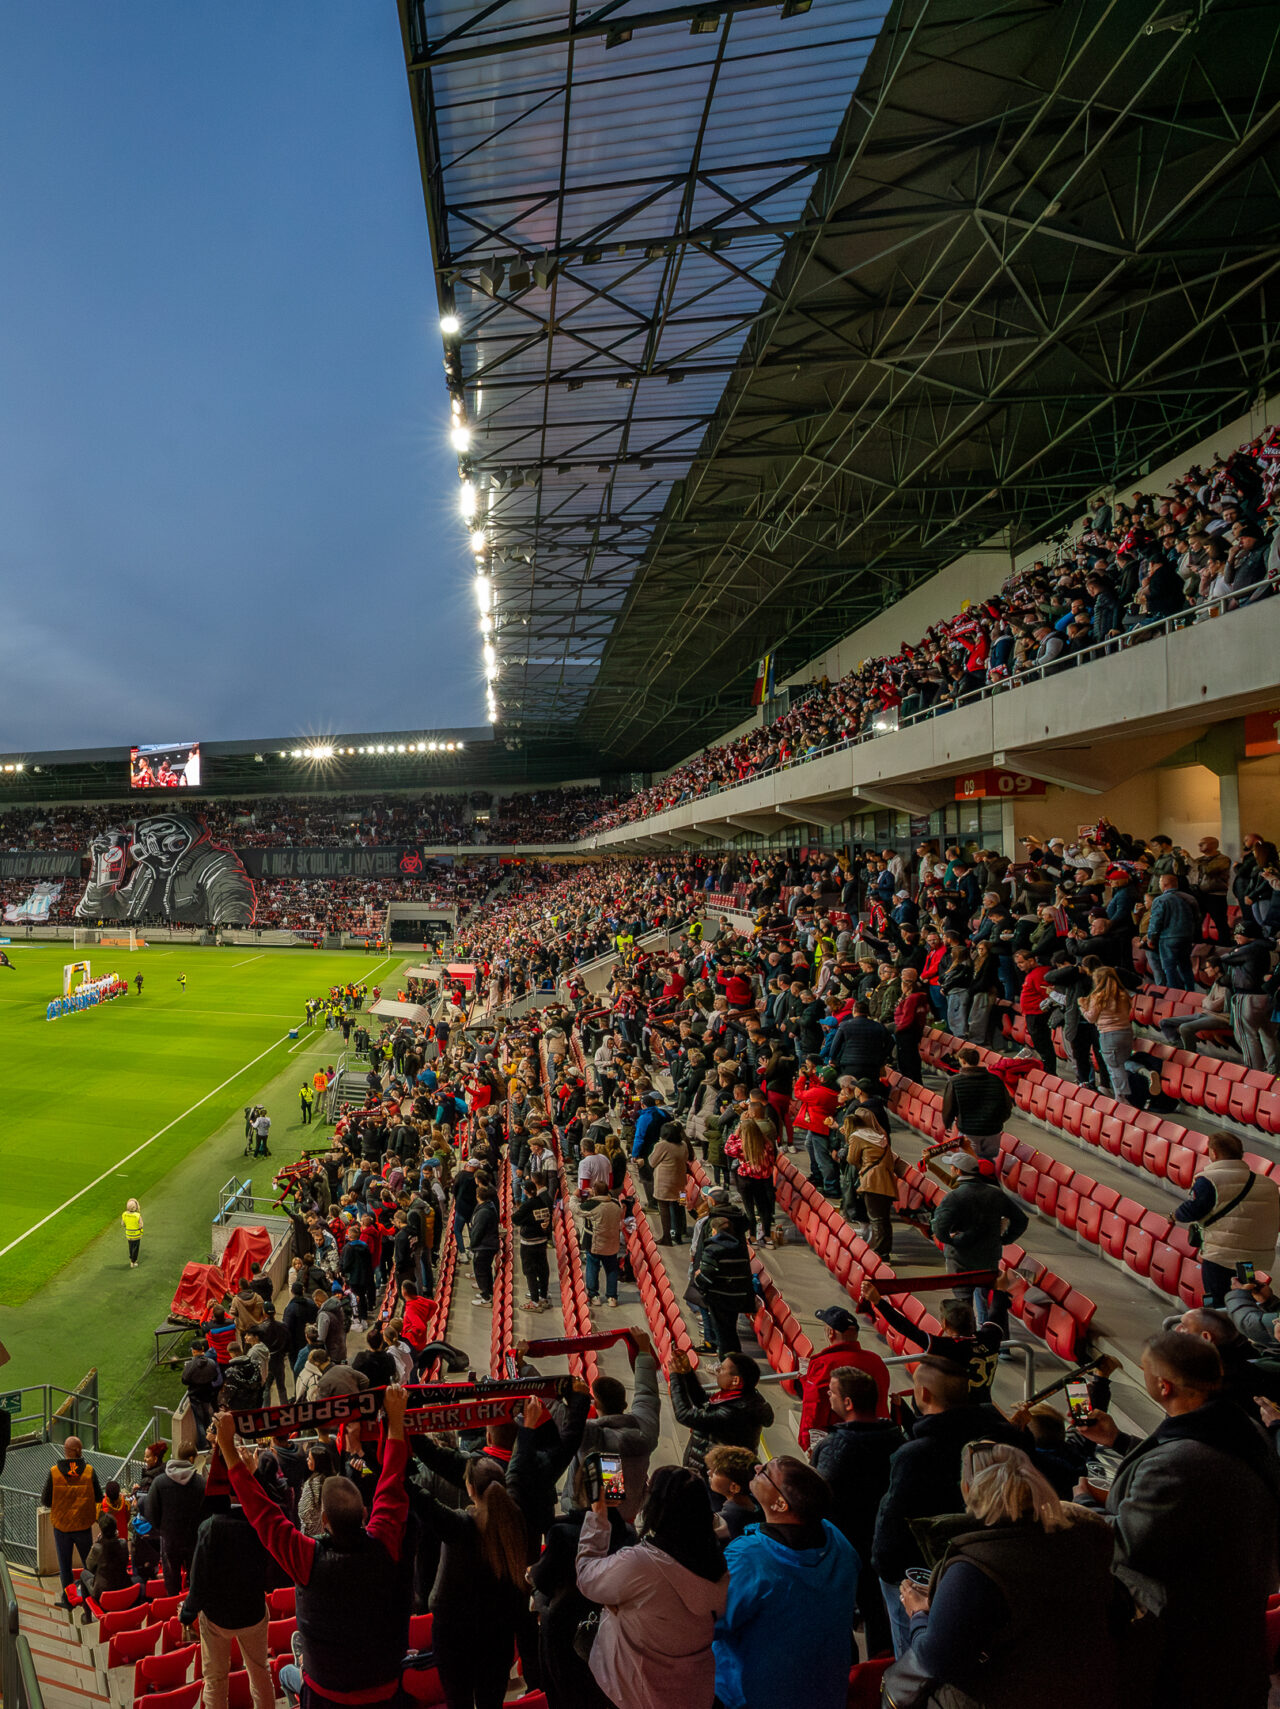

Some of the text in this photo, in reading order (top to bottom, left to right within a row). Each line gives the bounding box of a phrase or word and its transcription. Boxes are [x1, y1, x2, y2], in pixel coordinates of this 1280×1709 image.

[964, 780, 975, 795] 09
[998, 776, 1032, 792] 09
[968, 1353, 999, 1388] 37
[237, 1398, 350, 1434] SPARTA
[403, 1400, 506, 1427] SPARTAK
